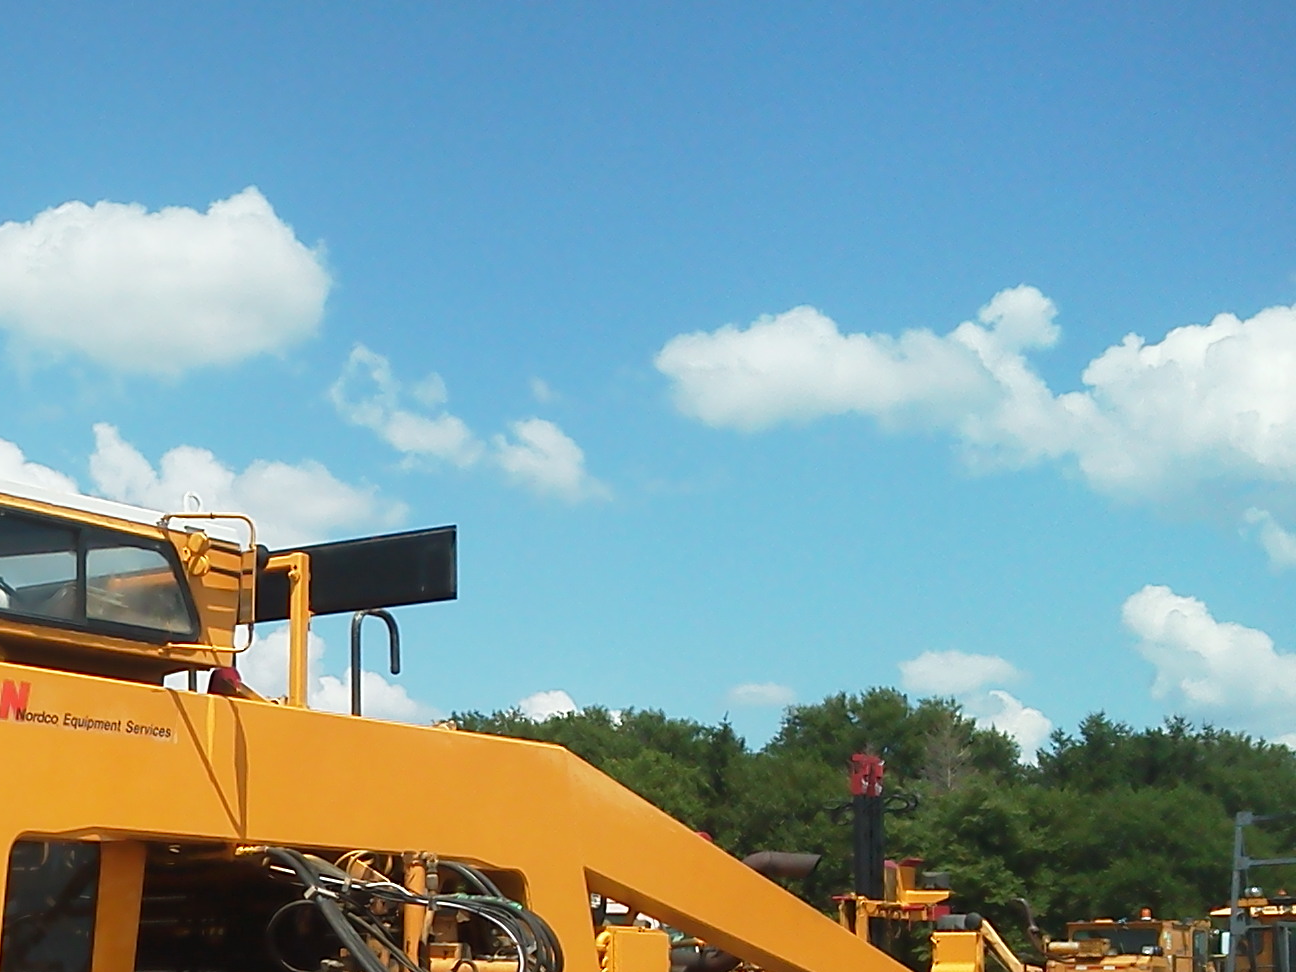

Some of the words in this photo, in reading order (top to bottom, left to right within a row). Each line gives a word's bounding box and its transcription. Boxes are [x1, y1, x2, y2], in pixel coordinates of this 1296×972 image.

[16, 708, 58, 724] Nordco
[63, 713, 121, 731] Equipment
[125, 720, 172, 738] Services
